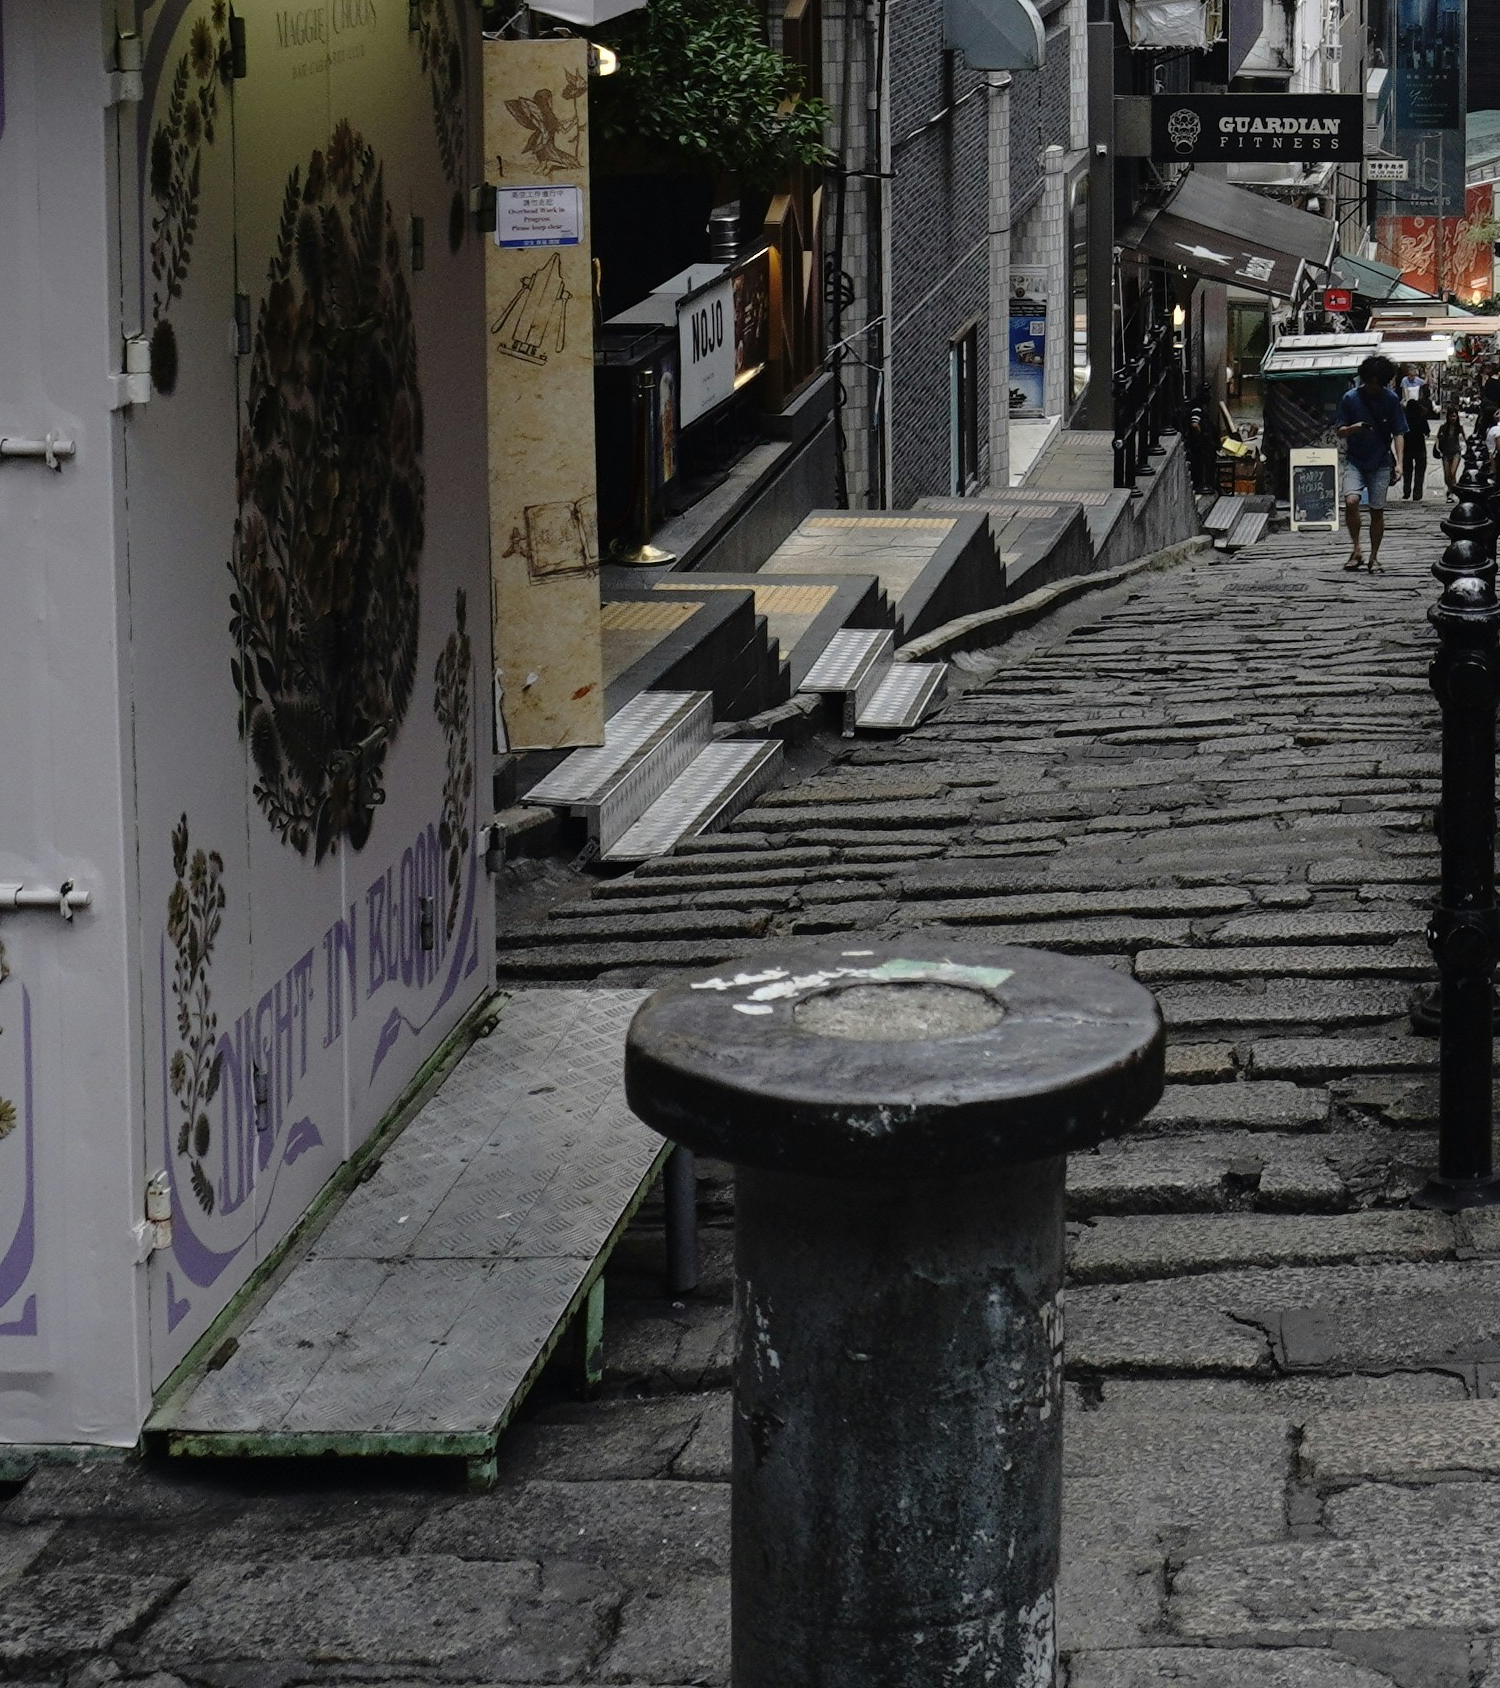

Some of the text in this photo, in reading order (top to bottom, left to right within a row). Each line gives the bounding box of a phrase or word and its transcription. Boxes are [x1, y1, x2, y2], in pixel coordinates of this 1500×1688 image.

[1218, 116, 1341, 135] GUARDIAN
[1219, 136, 1340, 150] FITNESS
[691, 299, 723, 364] NOJO
[1299, 470, 1325, 483] HAPPY
[1297, 482, 1325, 493] HOUR
[217, 946, 317, 1219] NIGHT
[322, 900, 358, 1050] IN
